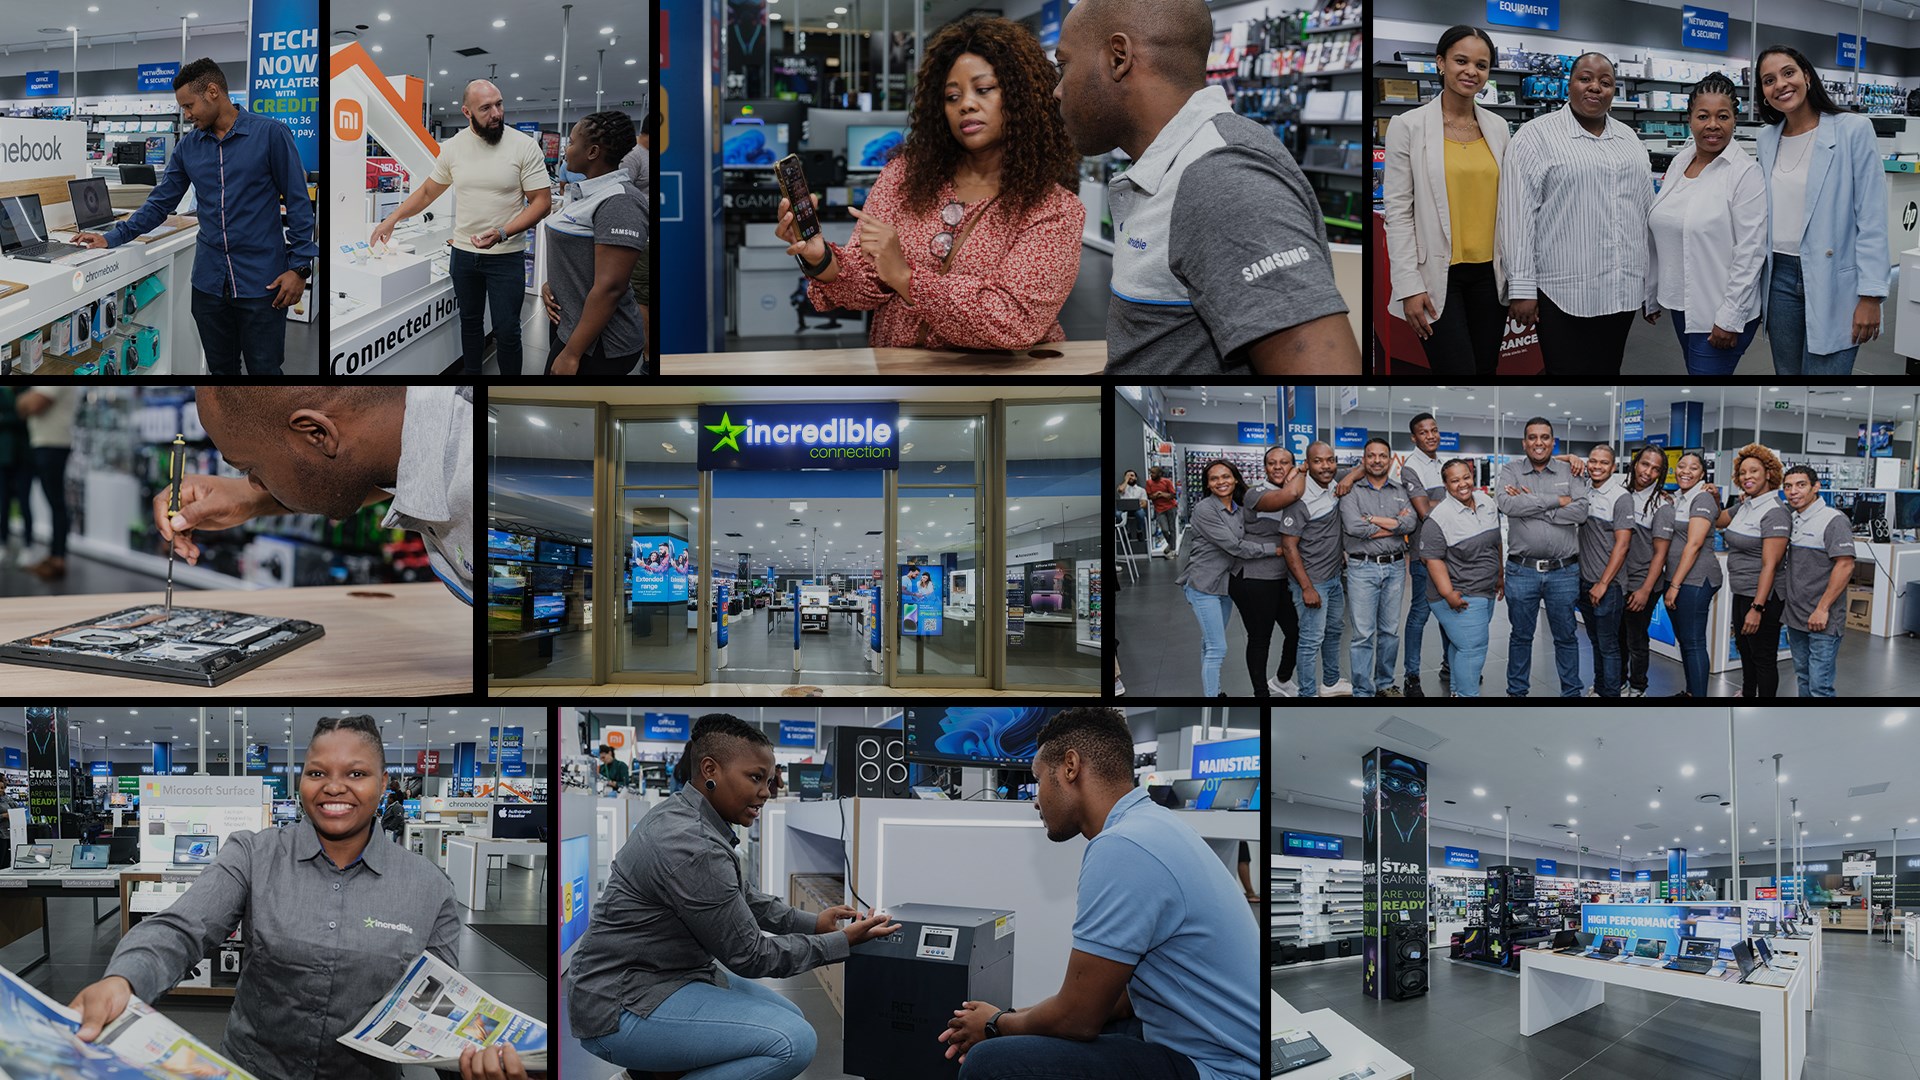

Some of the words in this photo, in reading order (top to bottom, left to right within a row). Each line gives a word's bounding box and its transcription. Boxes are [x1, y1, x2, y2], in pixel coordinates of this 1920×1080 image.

[1499, 1, 1549, 16] EQUIPMENT
[1688, 17, 1724, 29] NETWORKING
[259, 28, 318, 51] TECH
[1697, 30, 1721, 40] SECURITY
[258, 54, 318, 76] NOW
[142, 69, 175, 77] NETWORKING
[150, 76, 173, 84] SECURITY
[255, 78, 279, 90] PAY
[280, 77, 319, 89] LATER
[275, 89, 296, 97] WITH
[252, 97, 319, 114] CREDIT
[289, 116, 298, 125] to
[300, 116, 311, 125] 36
[298, 128, 316, 138] pay.
[1241, 246, 1310, 282] SAMSUNG
[85, 261, 120, 283] chromebook
[331, 304, 431, 375] Connected
[746, 418, 891, 445] incredible
[1288, 424, 1313, 434] FREE
[1291, 434, 1311, 456] 3
[809, 446, 891, 459] connection
[30, 769, 52, 779] STAR
[30, 779, 57, 787] GAMING
[163, 785, 213, 796] Microsoft
[215, 785, 255, 796] Surface
[31, 798, 57, 806] READY
[1381, 861, 1420, 875] STAR
[1381, 874, 1427, 885] GAMING
[1382, 890, 1403, 898] ARE
[1406, 890, 1425, 899] YOU
[1382, 900, 1426, 911] READY
[1382, 912, 1399, 923] TO
[1587, 915, 1607, 925] HIGH
[1609, 915, 1681, 929] PERFORMANCE
[375, 919, 413, 934] incredible
